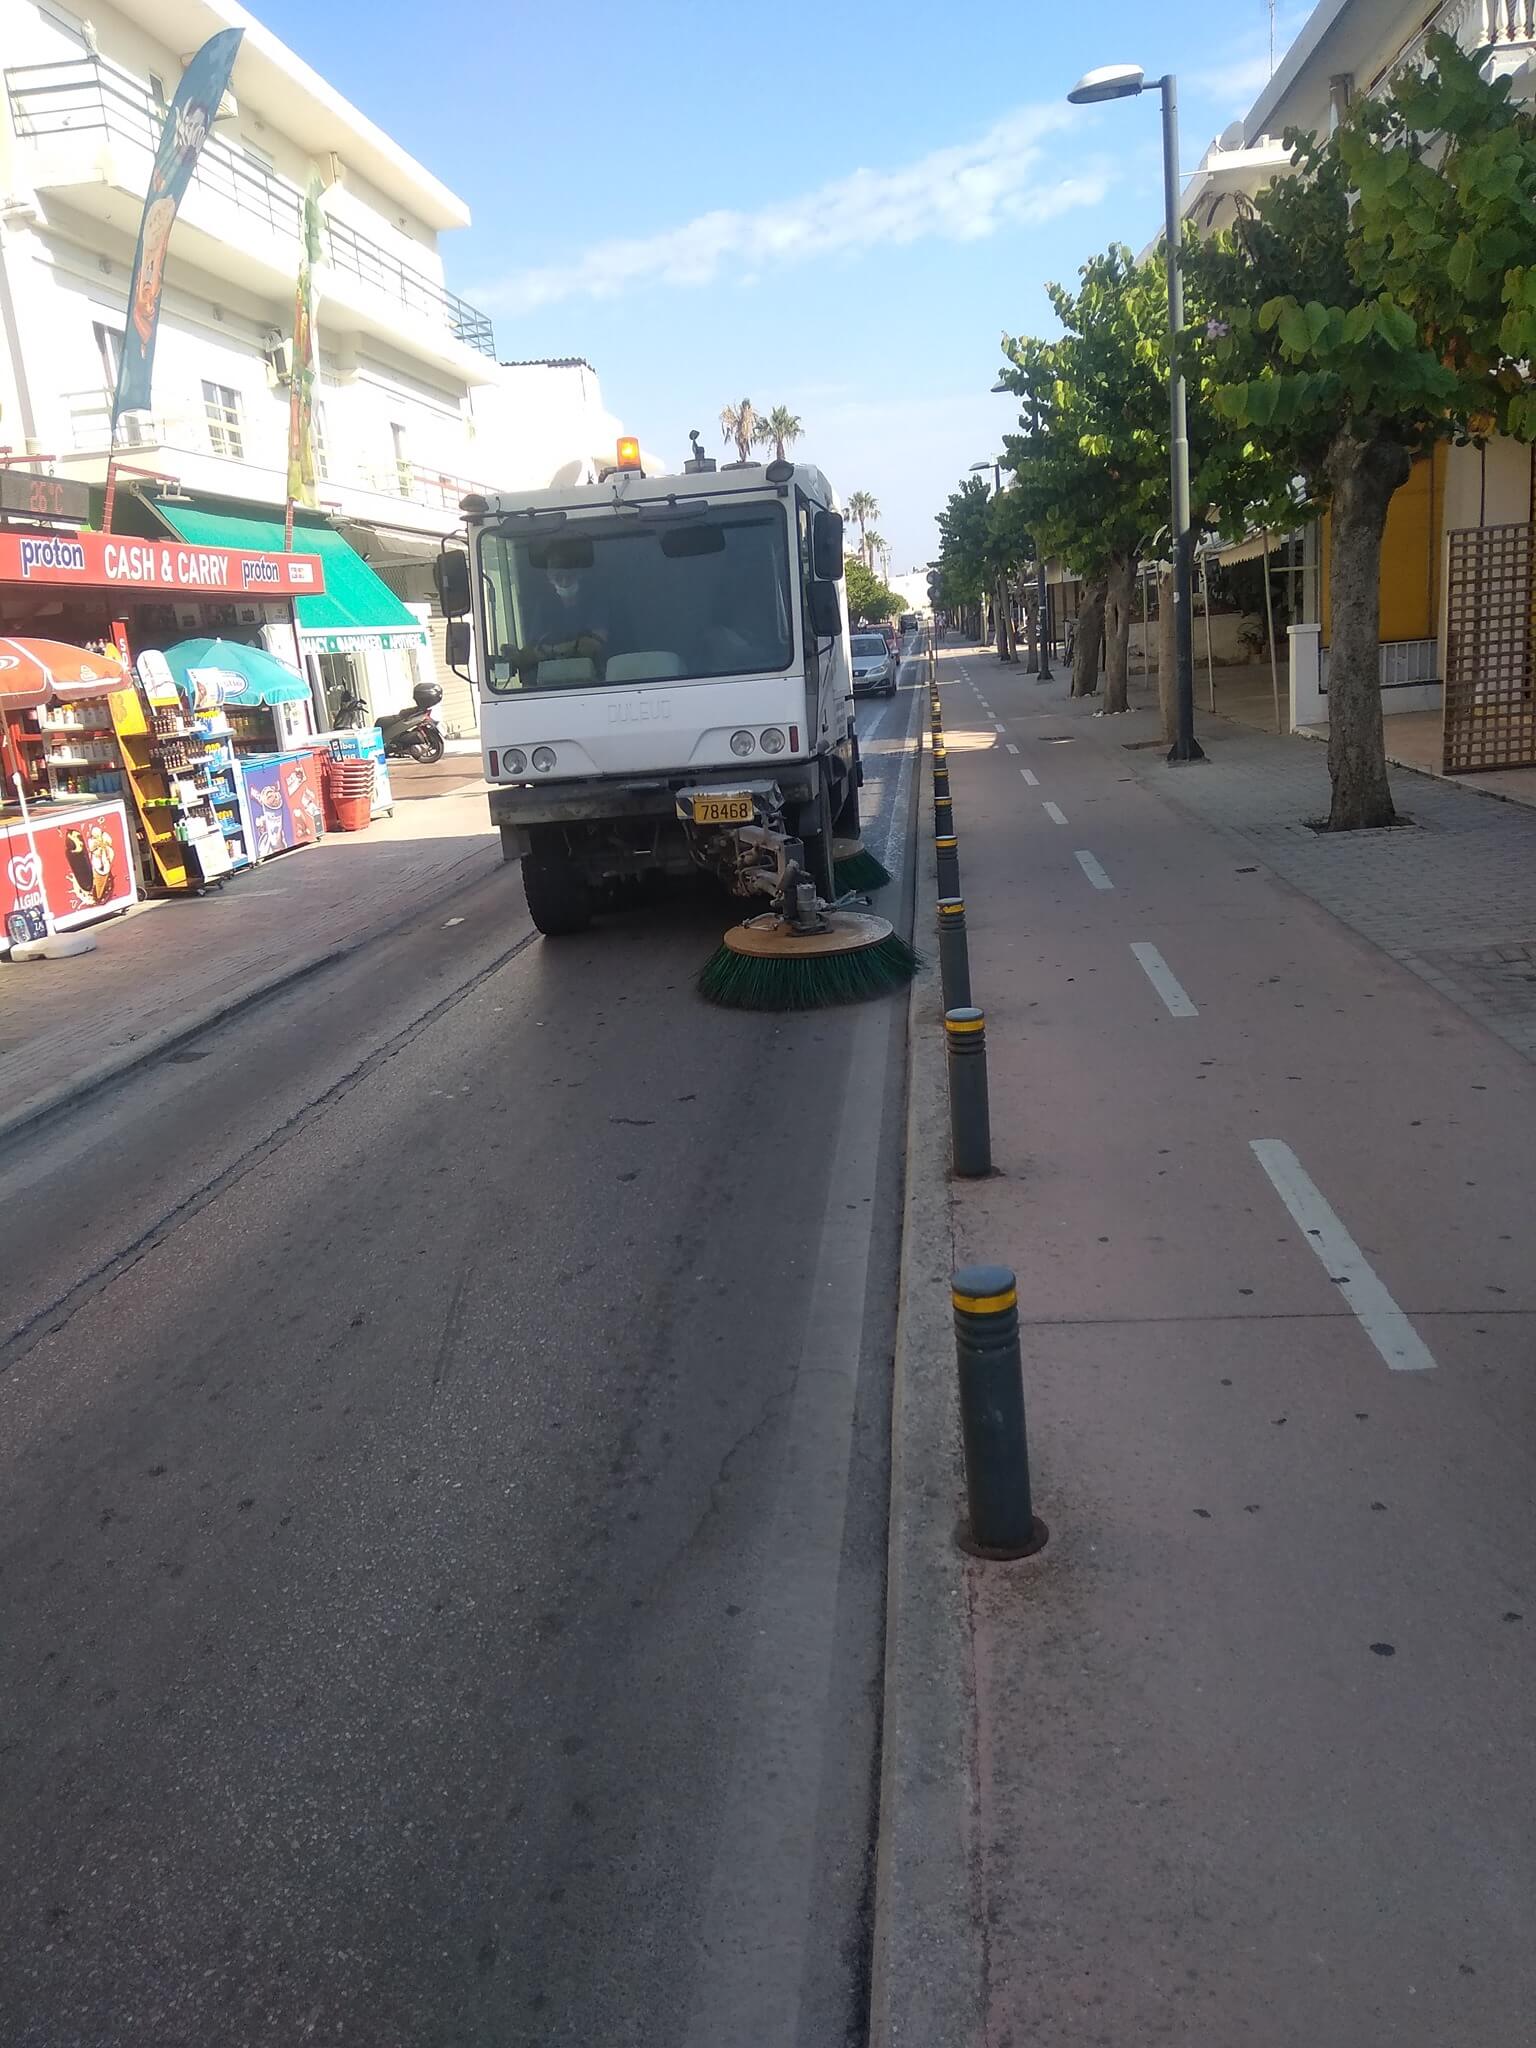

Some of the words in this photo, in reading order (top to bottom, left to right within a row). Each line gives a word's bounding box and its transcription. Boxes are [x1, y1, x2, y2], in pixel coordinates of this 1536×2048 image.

[20, 536, 85, 577] proton
[104, 544, 155, 580] CASH
[161, 550, 174, 583] &
[177, 551, 228, 585] CARRY
[242, 556, 280, 589] proton
[701, 803, 748, 820] 78468
[14, 891, 43, 911] ALGID
